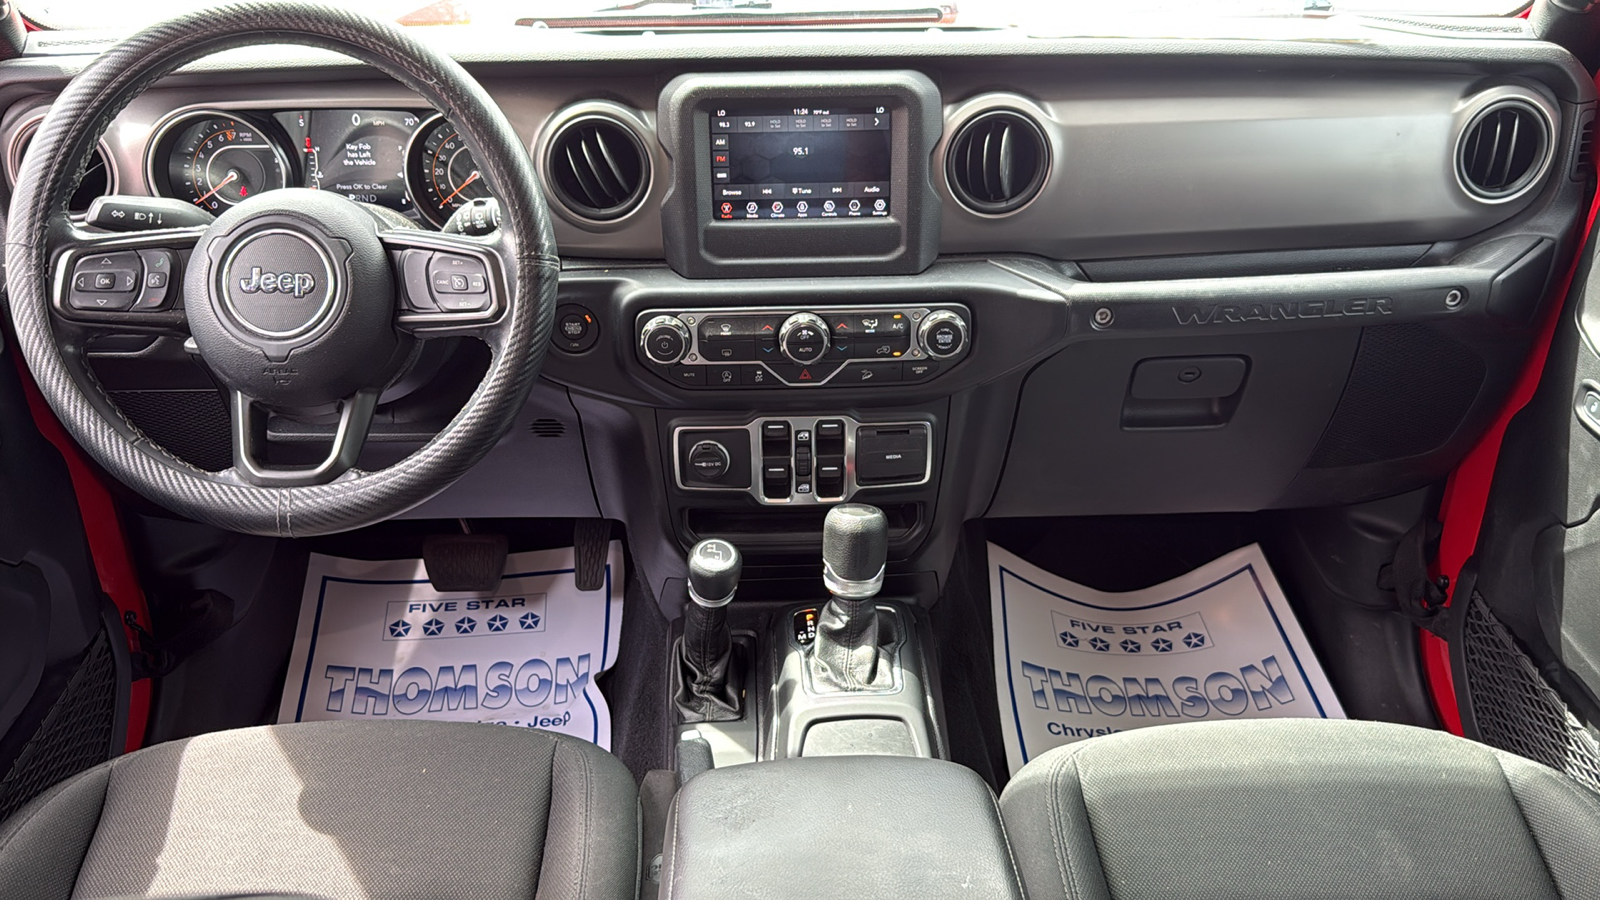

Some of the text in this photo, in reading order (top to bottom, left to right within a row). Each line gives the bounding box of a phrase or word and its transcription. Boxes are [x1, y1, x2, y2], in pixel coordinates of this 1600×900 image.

[351, 113, 361, 126] 0
[404, 118, 414, 126] 70
[218, 134, 224, 142] 6
[207, 141, 213, 149] 5
[346, 143, 358, 151] Key
[199, 151, 204, 159] 4
[793, 147, 808, 155] 95.1
[195, 164, 201, 172] 3
[197, 178, 203, 186] 2
[211, 201, 218, 209] 0
[239, 265, 316, 299] Jeep
[1171, 296, 1394, 325] WRANGLER
[408, 597, 526, 613] FIVE STAR
[1069, 618, 1183, 635] FIVE STAR
[325, 653, 591, 715] THOMSON
[1021, 655, 1295, 718] THOMSON
[527, 710, 571, 728] Jeep
